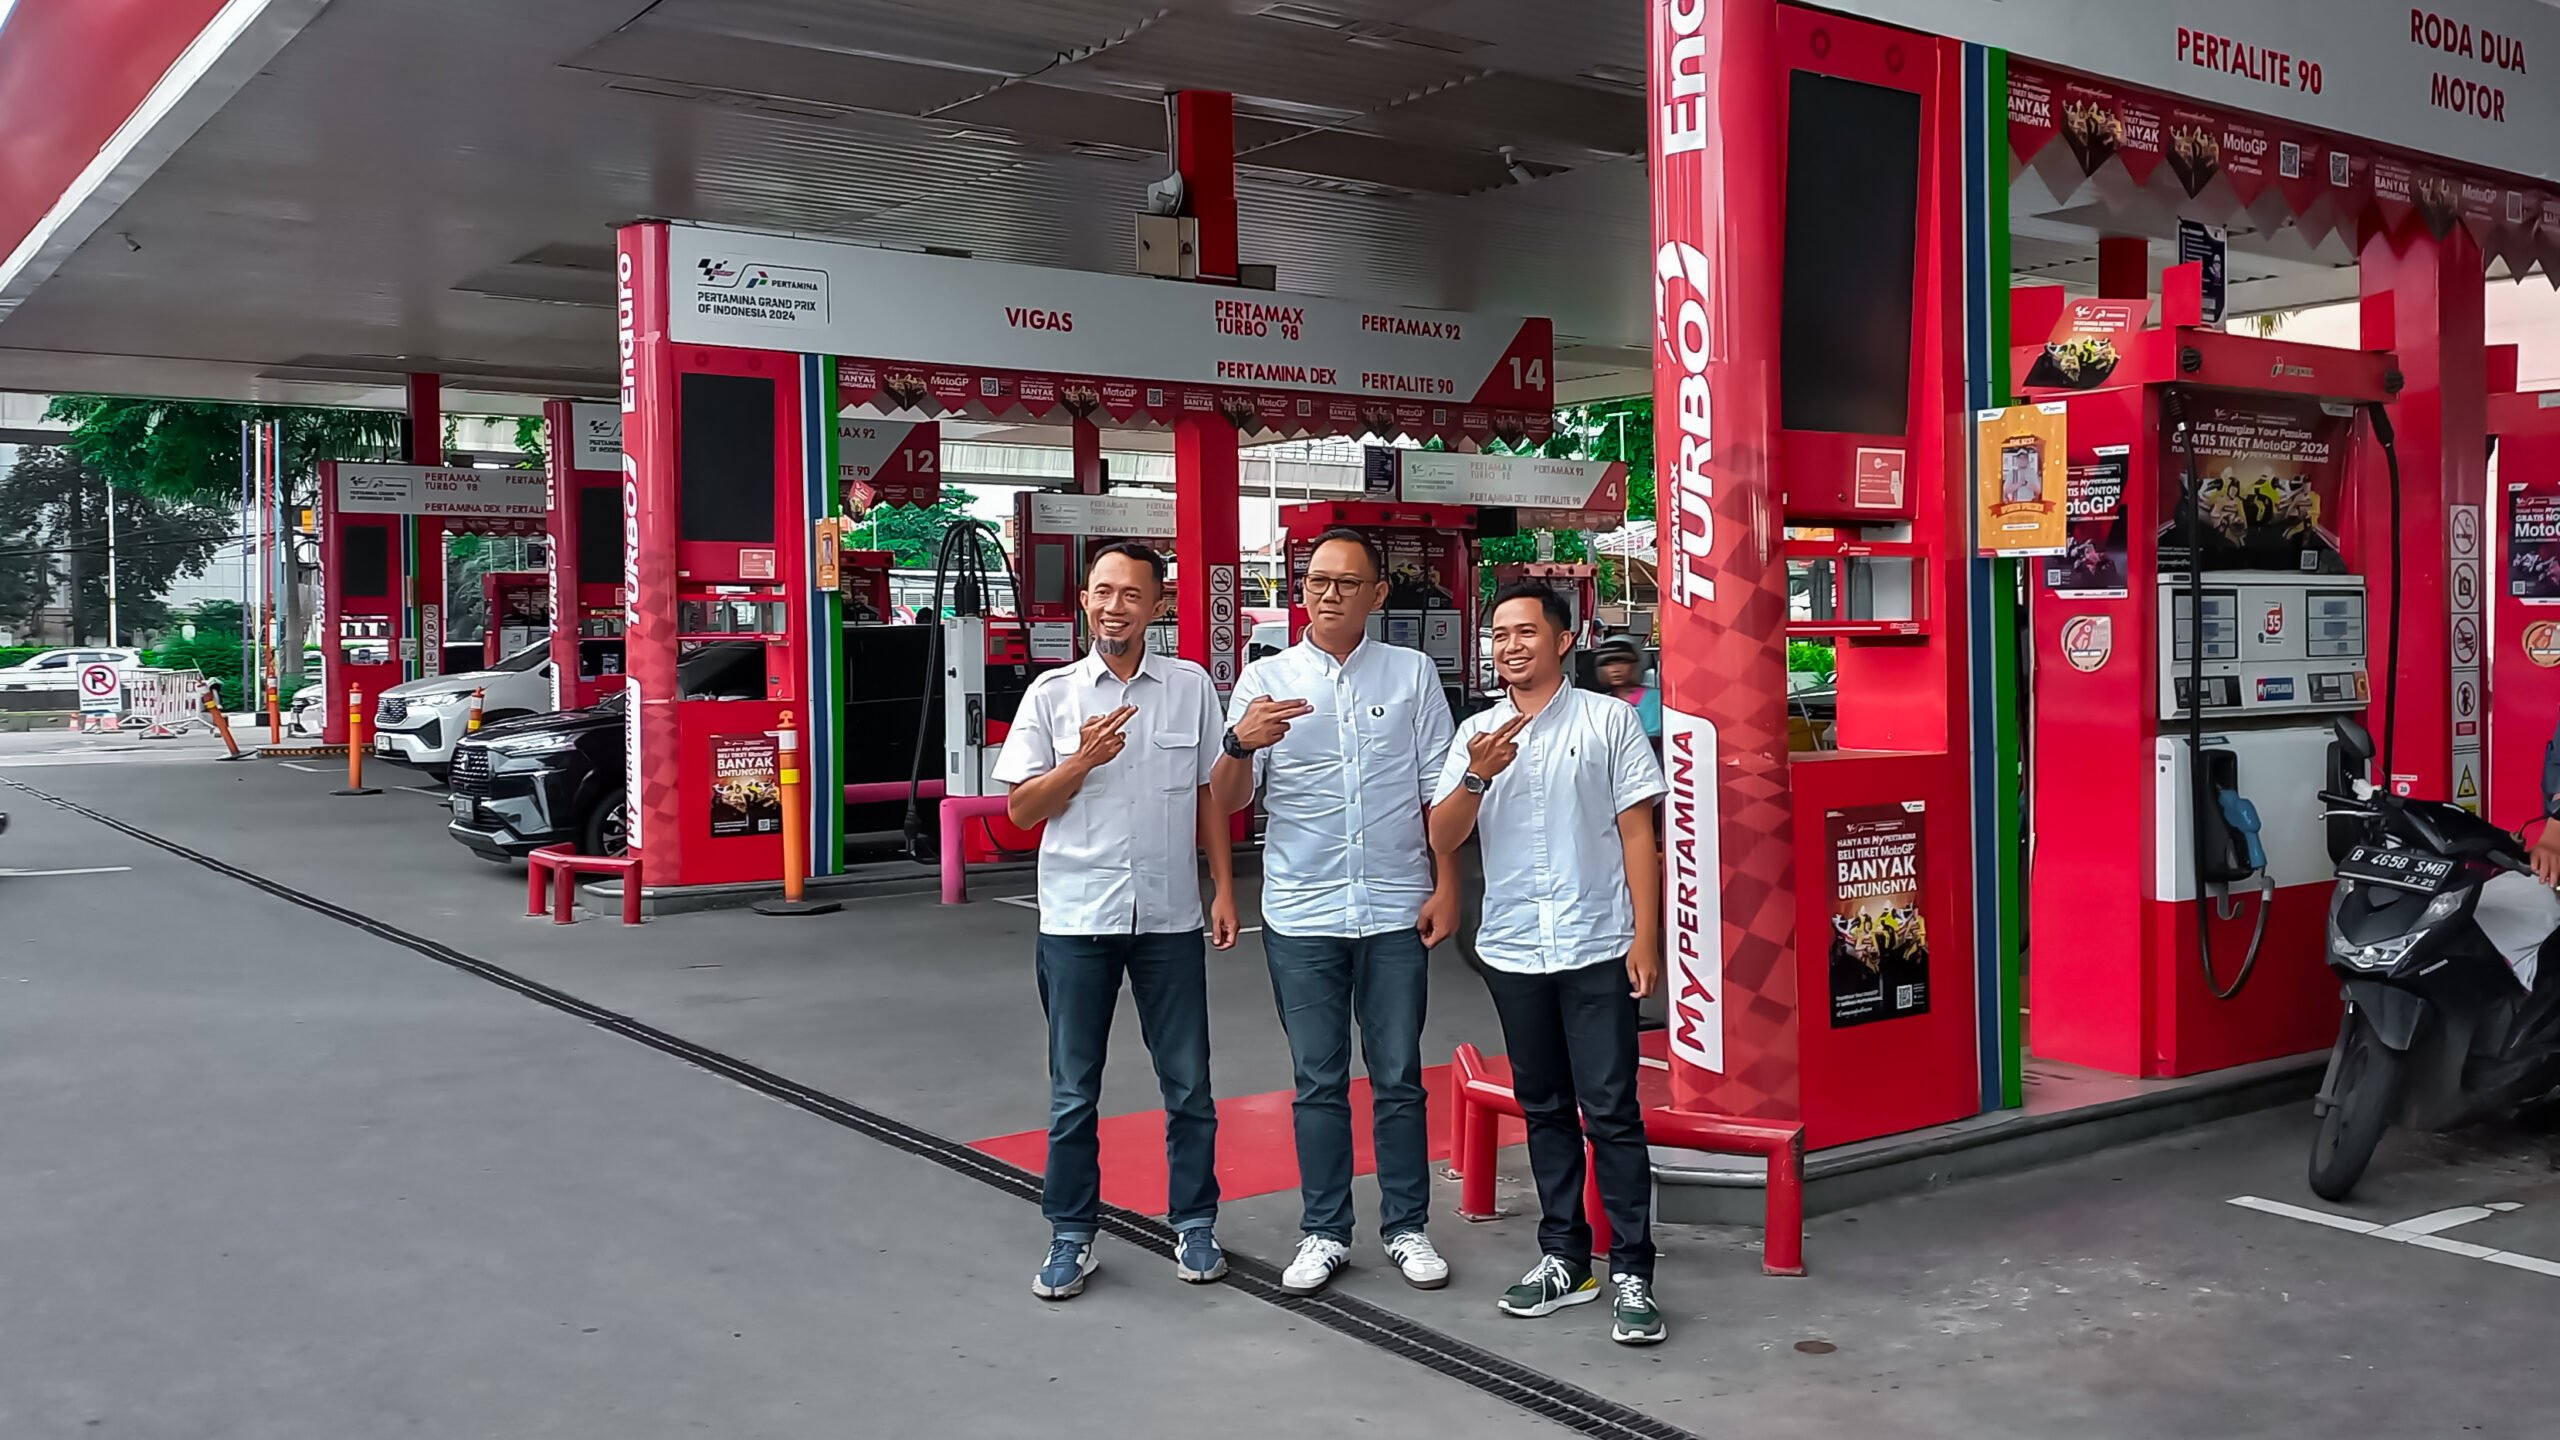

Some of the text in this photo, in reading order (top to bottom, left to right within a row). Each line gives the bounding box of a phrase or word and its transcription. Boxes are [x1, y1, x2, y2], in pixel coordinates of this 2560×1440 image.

[2410, 9, 2527, 75] RODA DUA
[2177, 26, 2323, 96] PERTALITE 90
[2431, 72, 2506, 123] MOTOR
[2008, 97, 2051, 118] ANYAK
[2008, 111, 2051, 129] TUNGNYA
[2126, 124, 2160, 143] NYAK
[2223, 132, 2268, 156] MotoGP
[2375, 175, 2410, 194] BANYAK
[2462, 184, 2497, 203] MotoGP
[771, 279, 819, 291] PERTAMINA
[697, 291, 816, 311] PERTAMINA GRAND PRIX
[698, 303, 796, 321] OF INDONESIA 2024
[1005, 306, 1073, 332] VIGAS
[1215, 300, 1304, 324] PERTAMAX
[618, 252, 637, 413] Enduro
[1216, 317, 1300, 340] TURBO 98
[1361, 314, 1461, 340] PERTAMAX 92
[931, 376, 969, 386] MotoGP
[1217, 361, 1337, 385] PERTAMINA DEX
[1509, 357, 1546, 391] 14
[1020, 387, 1053, 397] BANYAK
[1103, 387, 1137, 397] MotoGP
[1362, 372, 1454, 394] PERTALITE 90
[863, 428, 876, 439] 92
[2172, 431, 2329, 455] GATIS TIKET MotoGP 2024
[904, 449, 934, 473] 12
[1678, 298, 1715, 608] TURBO
[544, 418, 555, 510] Enduro
[857, 465, 870, 476] 90
[1534, 465, 1574, 476] PERTAMAX
[425, 472, 481, 482] PERTAMAX
[425, 482, 457, 491] TURBO
[505, 475, 547, 484] PERTAM
[1534, 495, 1571, 504] PERTALITE
[1606, 482, 1617, 501] 4
[2080, 485, 2120, 496] NONTON
[425, 503, 500, 513] PERTAMINA DEX
[506, 505, 547, 514] PERTALI
[2066, 495, 2116, 515] otoGP
[2515, 514, 2544, 522] GRATIS
[1671, 462, 1682, 604] PERTAMAX
[622, 480, 640, 628] TURBO
[717, 757, 774, 769] BANYAK
[718, 768, 774, 777] UNTUNGNYA
[1837, 838, 1862, 847] HANYA
[1863, 837, 1870, 845] DI
[1838, 843, 1915, 861] BELI TIKET MotoGP
[1838, 855, 1916, 883] BANYAK
[2351, 849, 2446, 876] B 4658 SMB
[1672, 731, 1715, 1053] MyPERTAMINA
[1838, 878, 1917, 899] UNTUNGNYA
